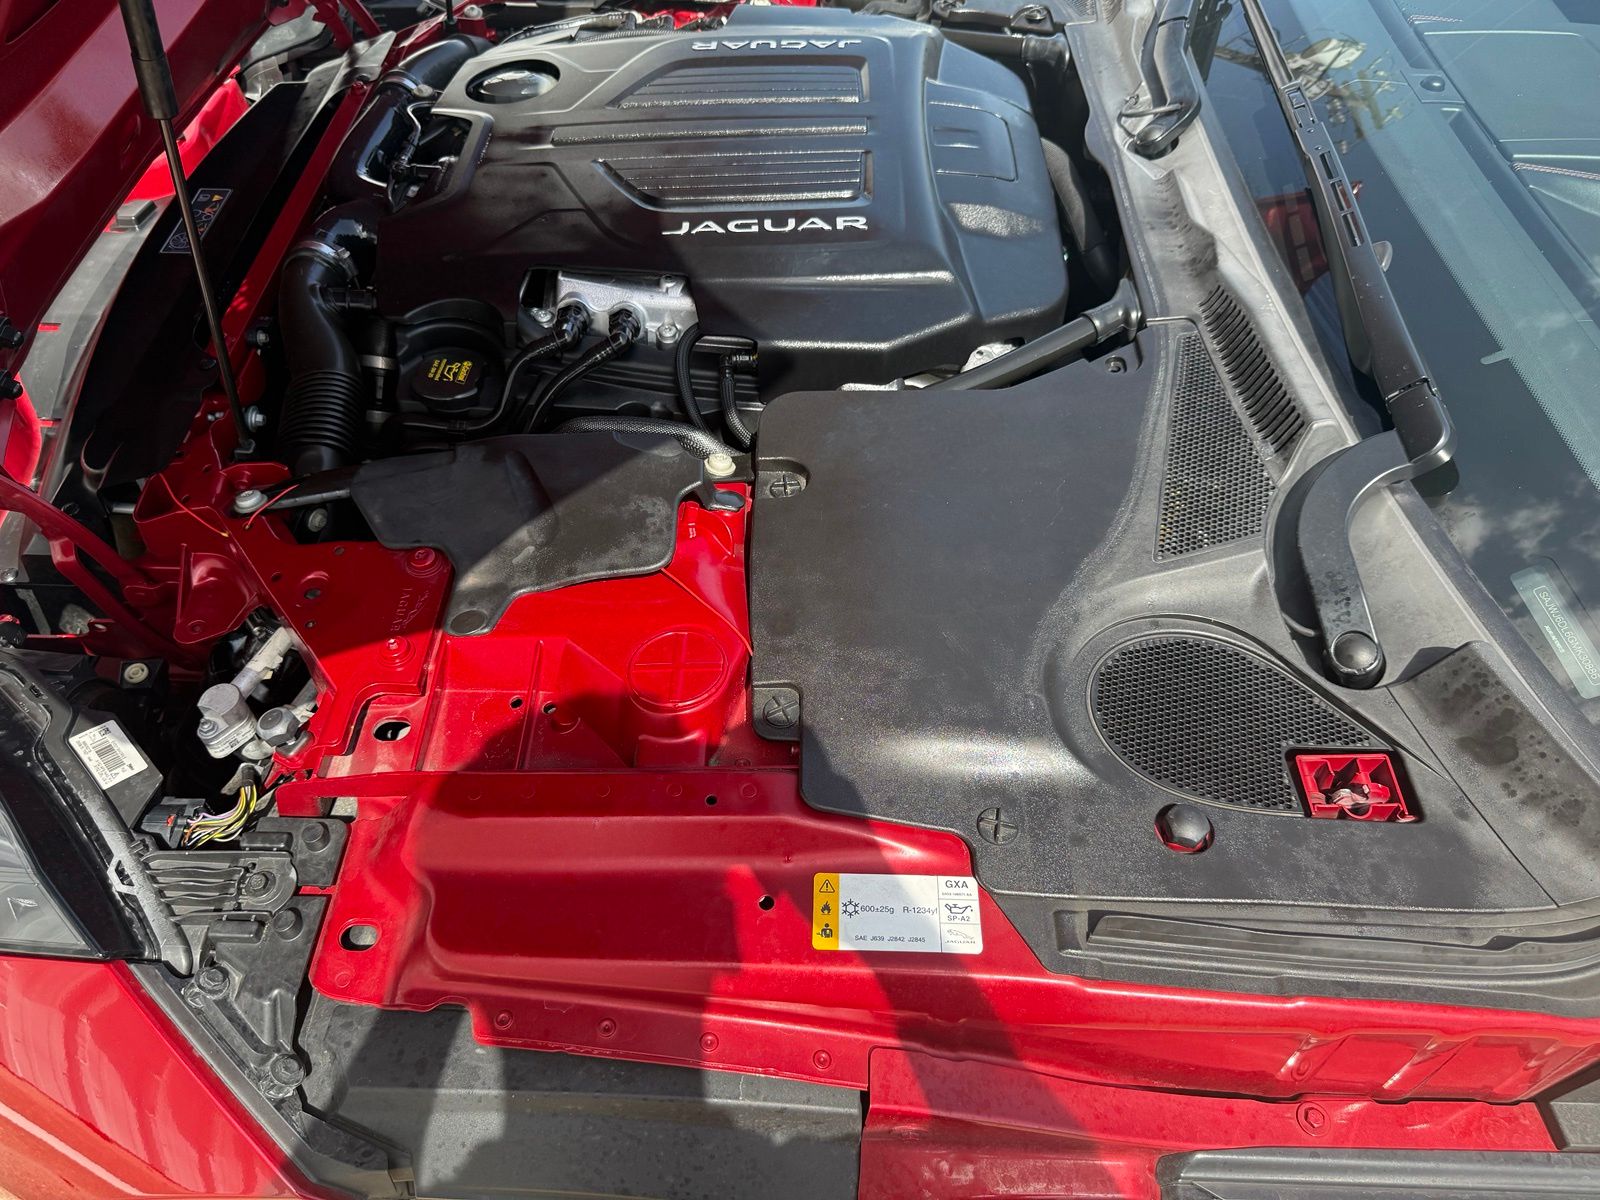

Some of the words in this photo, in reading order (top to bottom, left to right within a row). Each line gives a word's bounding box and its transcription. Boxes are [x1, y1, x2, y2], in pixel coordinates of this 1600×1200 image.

[691, 38, 862, 50] JAGUAR
[661, 215, 868, 236] JAGUAR
[945, 879, 969, 889] GXA
[947, 914, 971, 922] SP-A2
[854, 934, 868, 942] SAE
[907, 935, 926, 943] J2845
